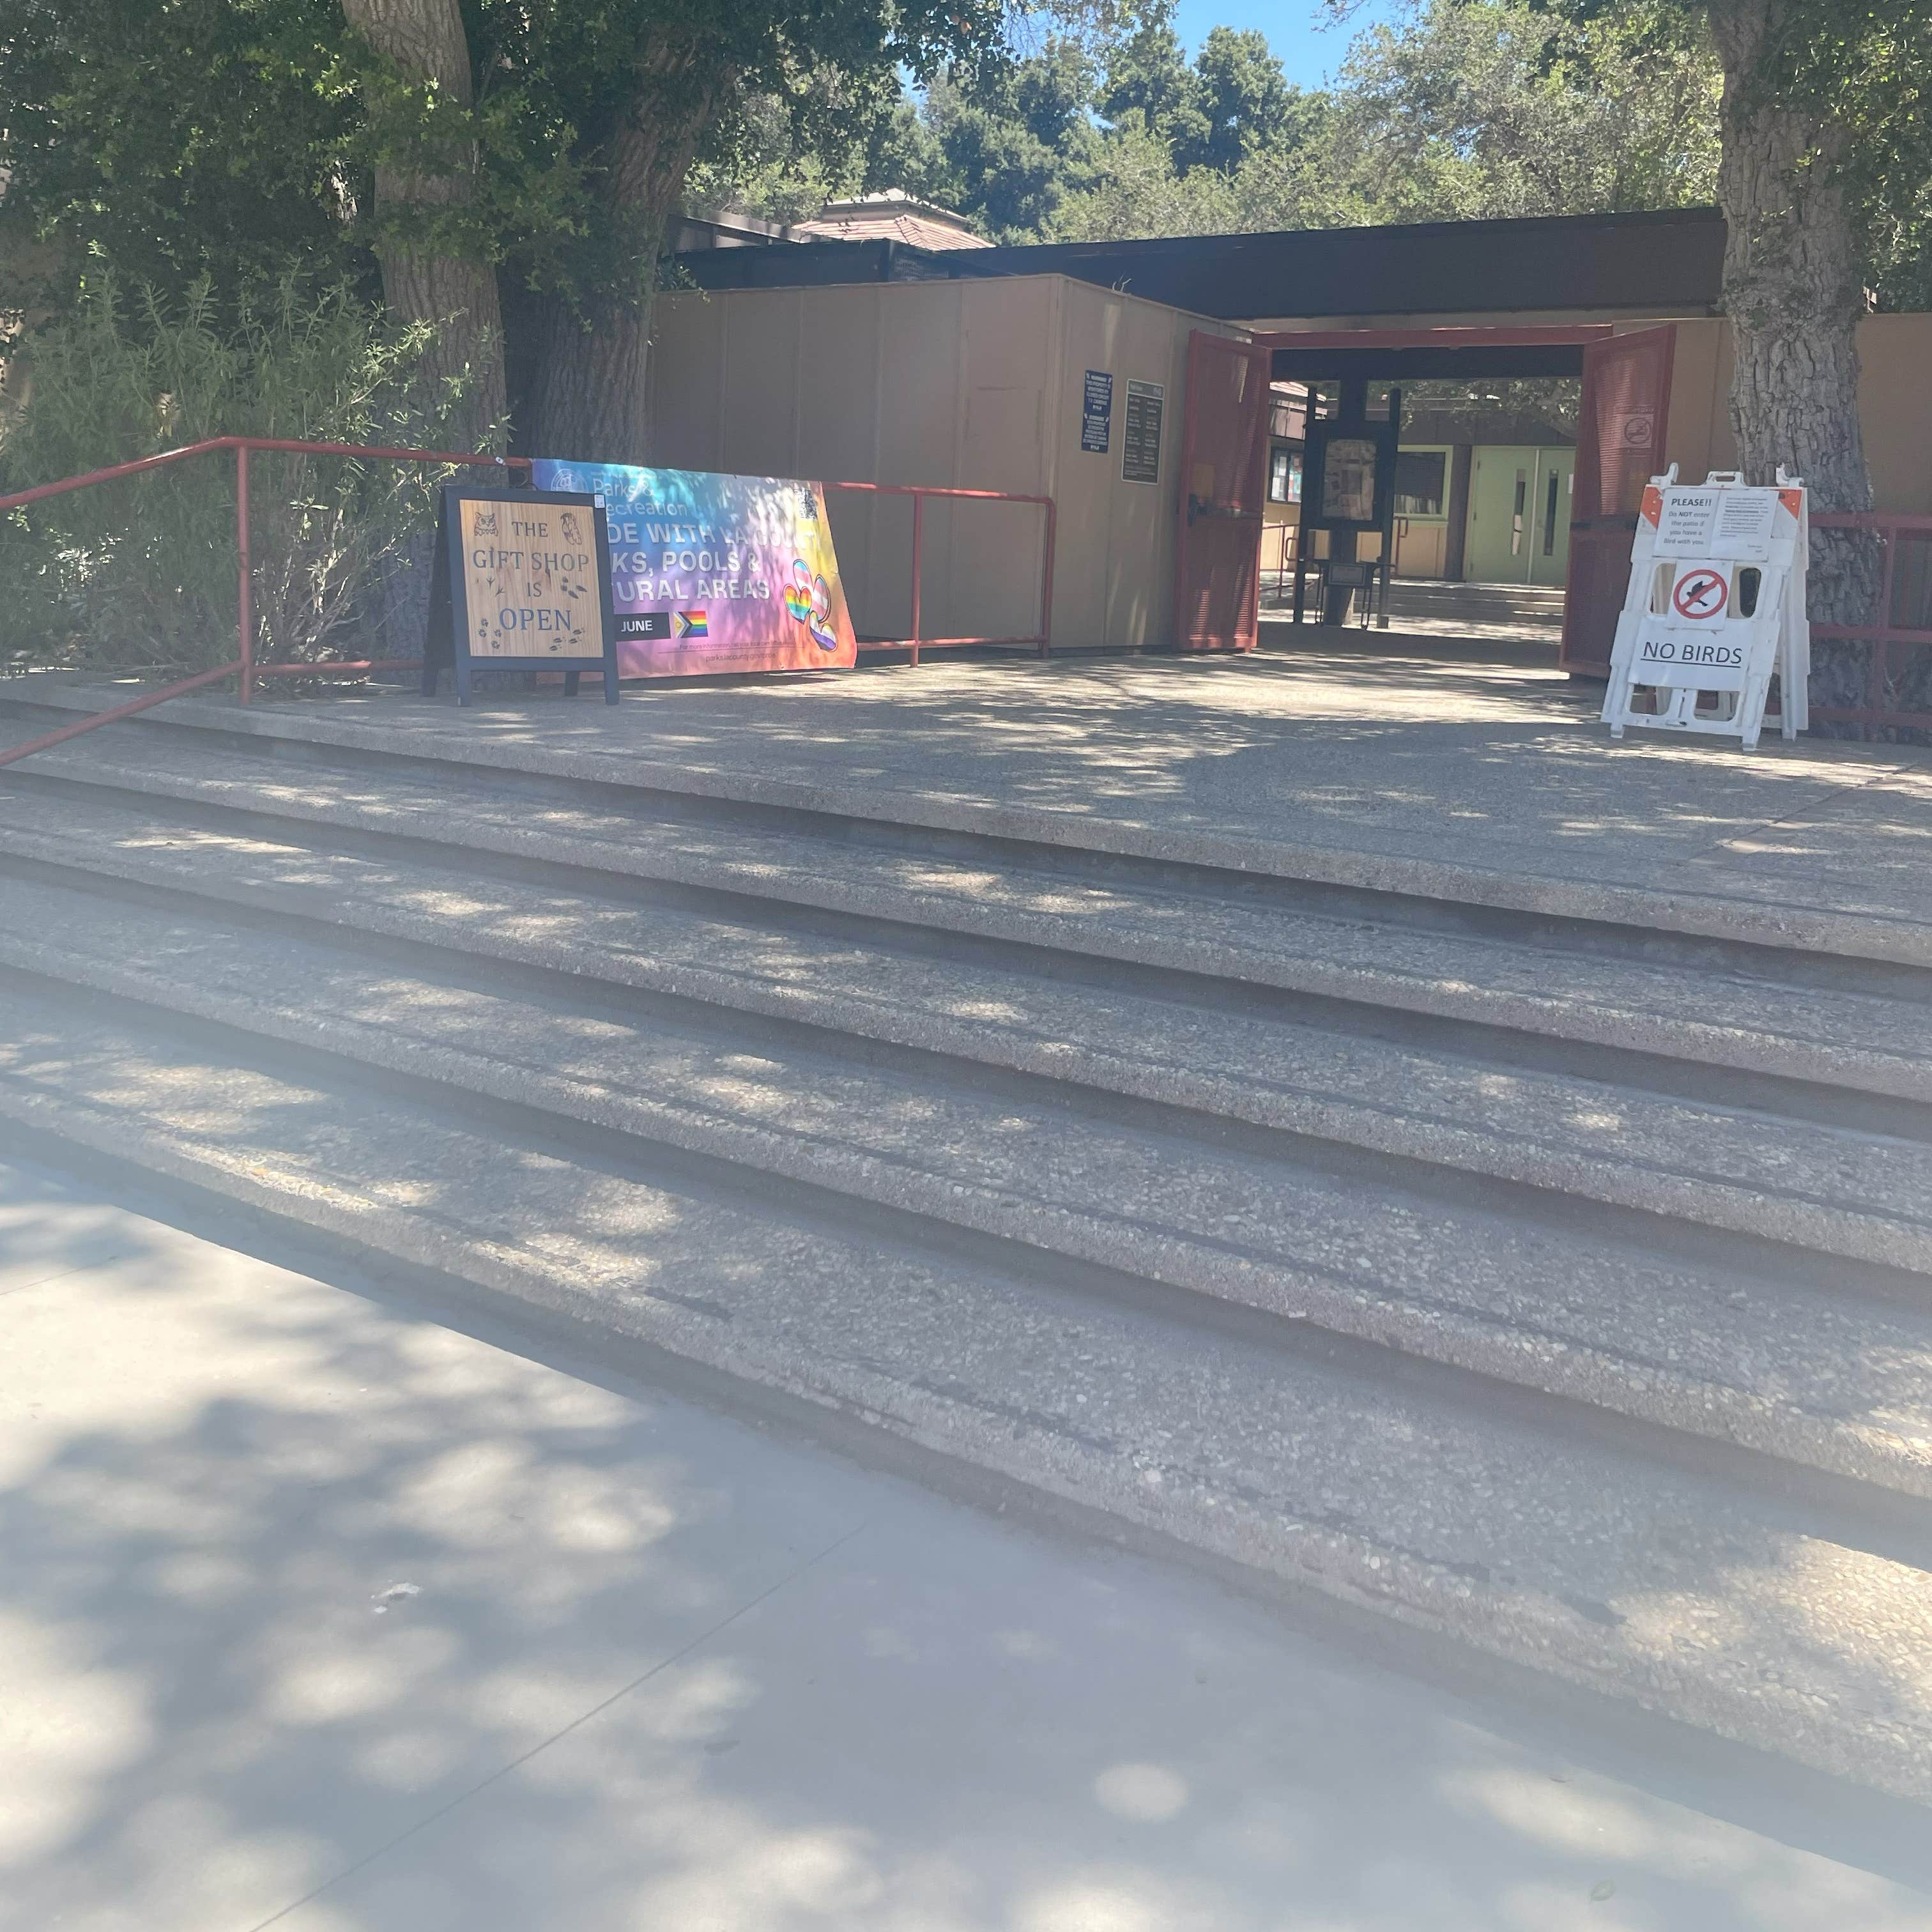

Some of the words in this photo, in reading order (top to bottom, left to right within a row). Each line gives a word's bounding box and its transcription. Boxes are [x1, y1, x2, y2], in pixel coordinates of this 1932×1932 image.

[593, 477, 634, 496] Parks
[606, 500, 687, 517] ecreation
[512, 521, 548, 537] THE
[608, 523, 637, 544] DE
[646, 523, 716, 544] WITH
[473, 549, 524, 569] GIFT
[531, 552, 589, 572] SHOP
[612, 552, 654, 578] KS,
[662, 551, 741, 572] POOLS
[747, 552, 762, 572] &
[527, 582, 542, 597] IS
[611, 579, 689, 602] URAL
[697, 579, 770, 599] AREAS
[499, 608, 571, 631] OPEN
[621, 620, 653, 632] JUNE
[1643, 641, 1675, 659] NO
[1682, 645, 1742, 664] BIRDS
